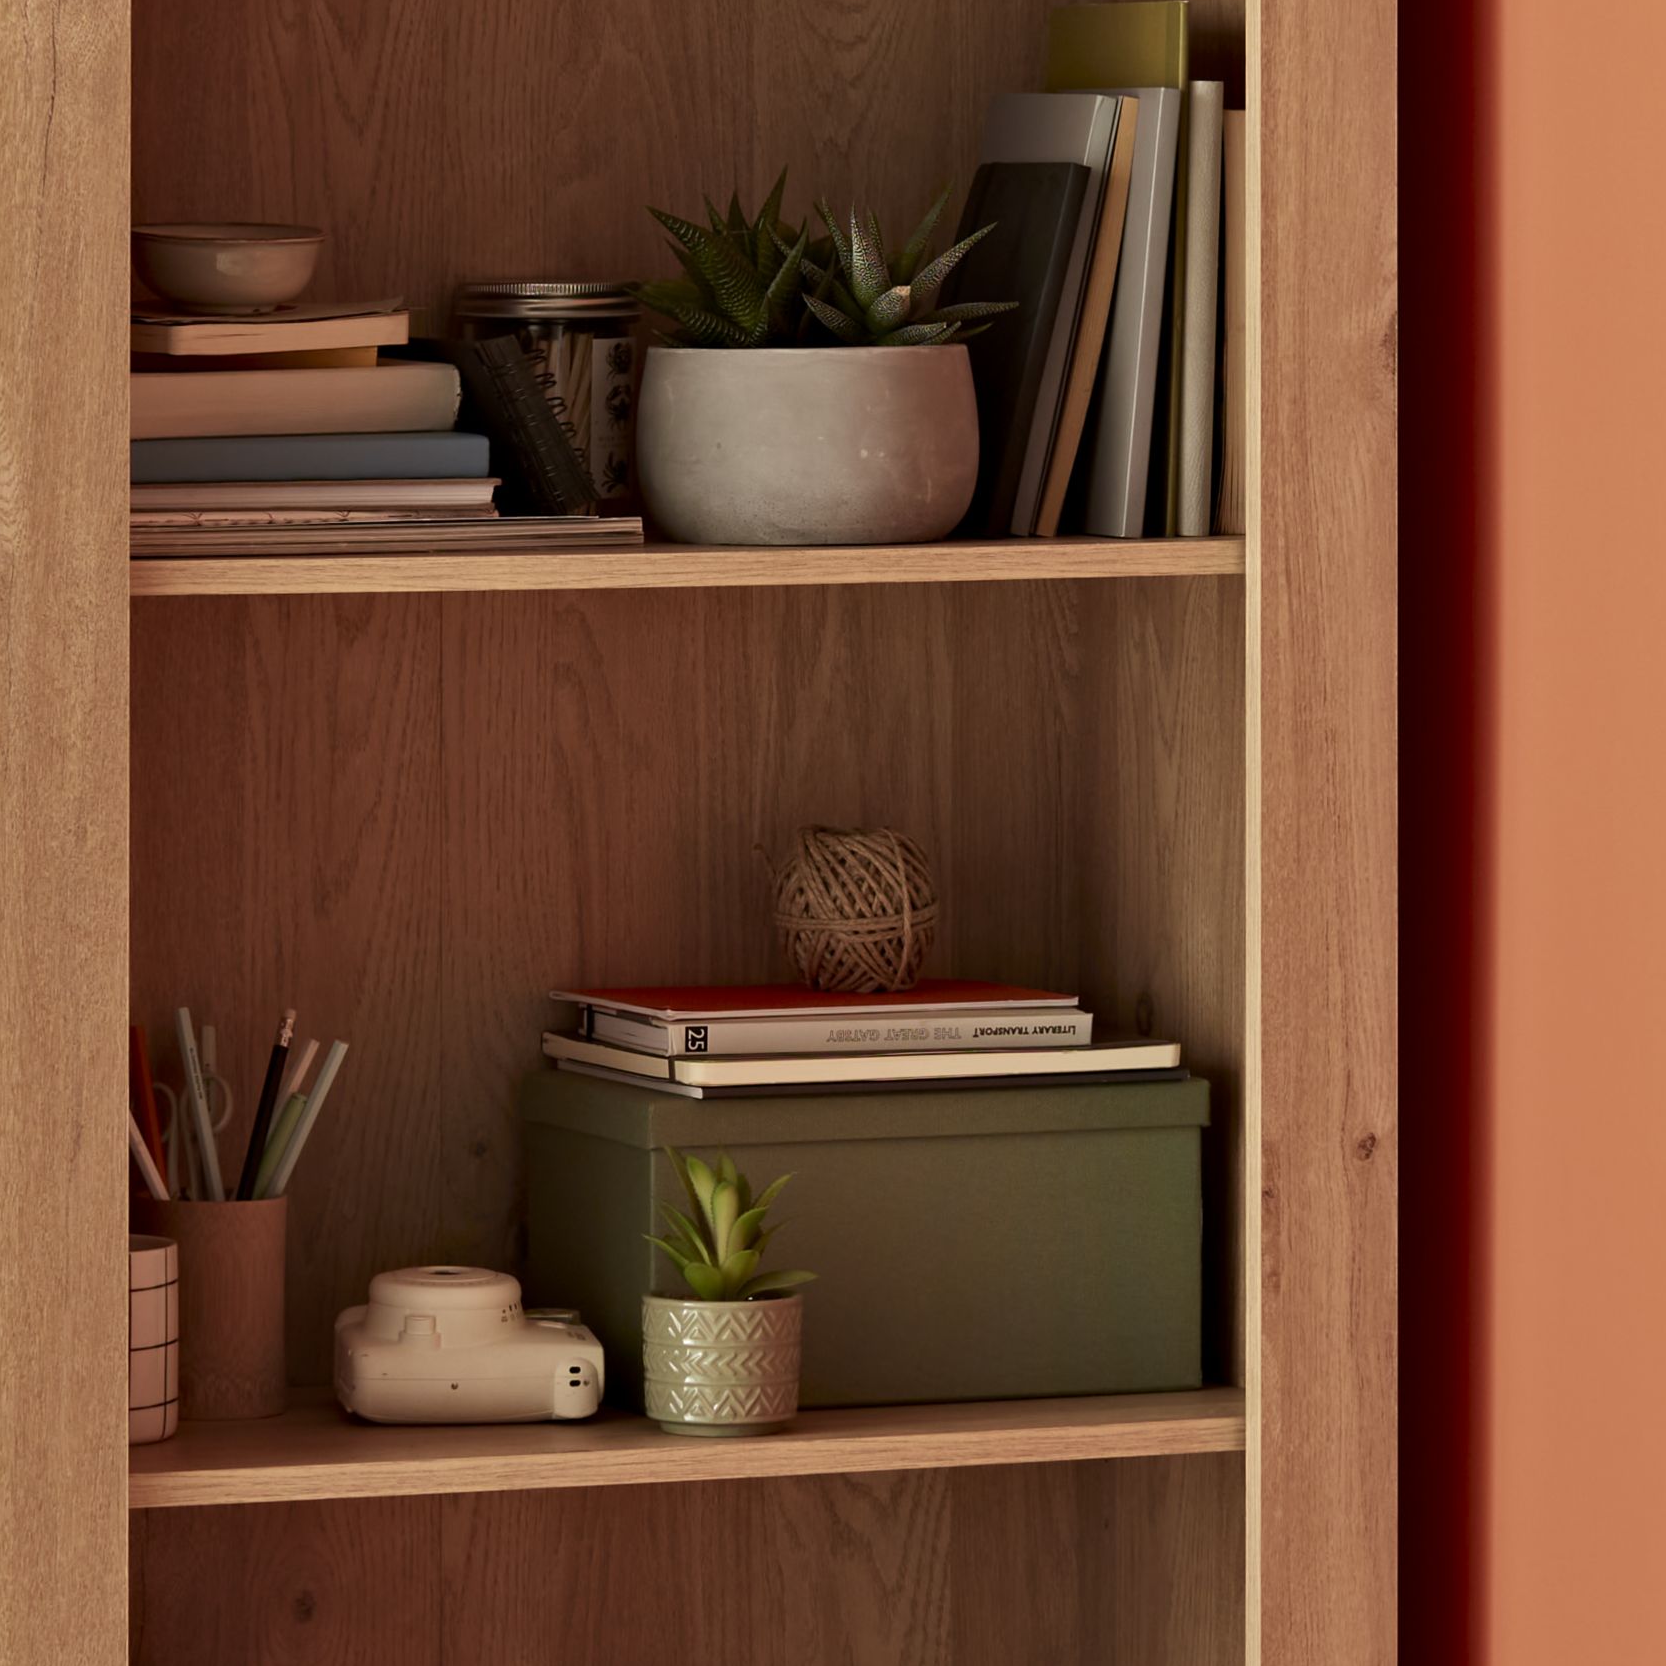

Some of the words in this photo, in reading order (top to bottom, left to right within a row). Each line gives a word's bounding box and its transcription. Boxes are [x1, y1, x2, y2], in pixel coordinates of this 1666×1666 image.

[826, 1028, 881, 1043] GATSBY
[883, 1027, 931, 1042] GREAT
[933, 1027, 962, 1041] THE
[972, 1026, 1029, 1038] TRANSPORT
[1031, 1025, 1076, 1036] LITERARY
[688, 1028, 705, 1050] 25
